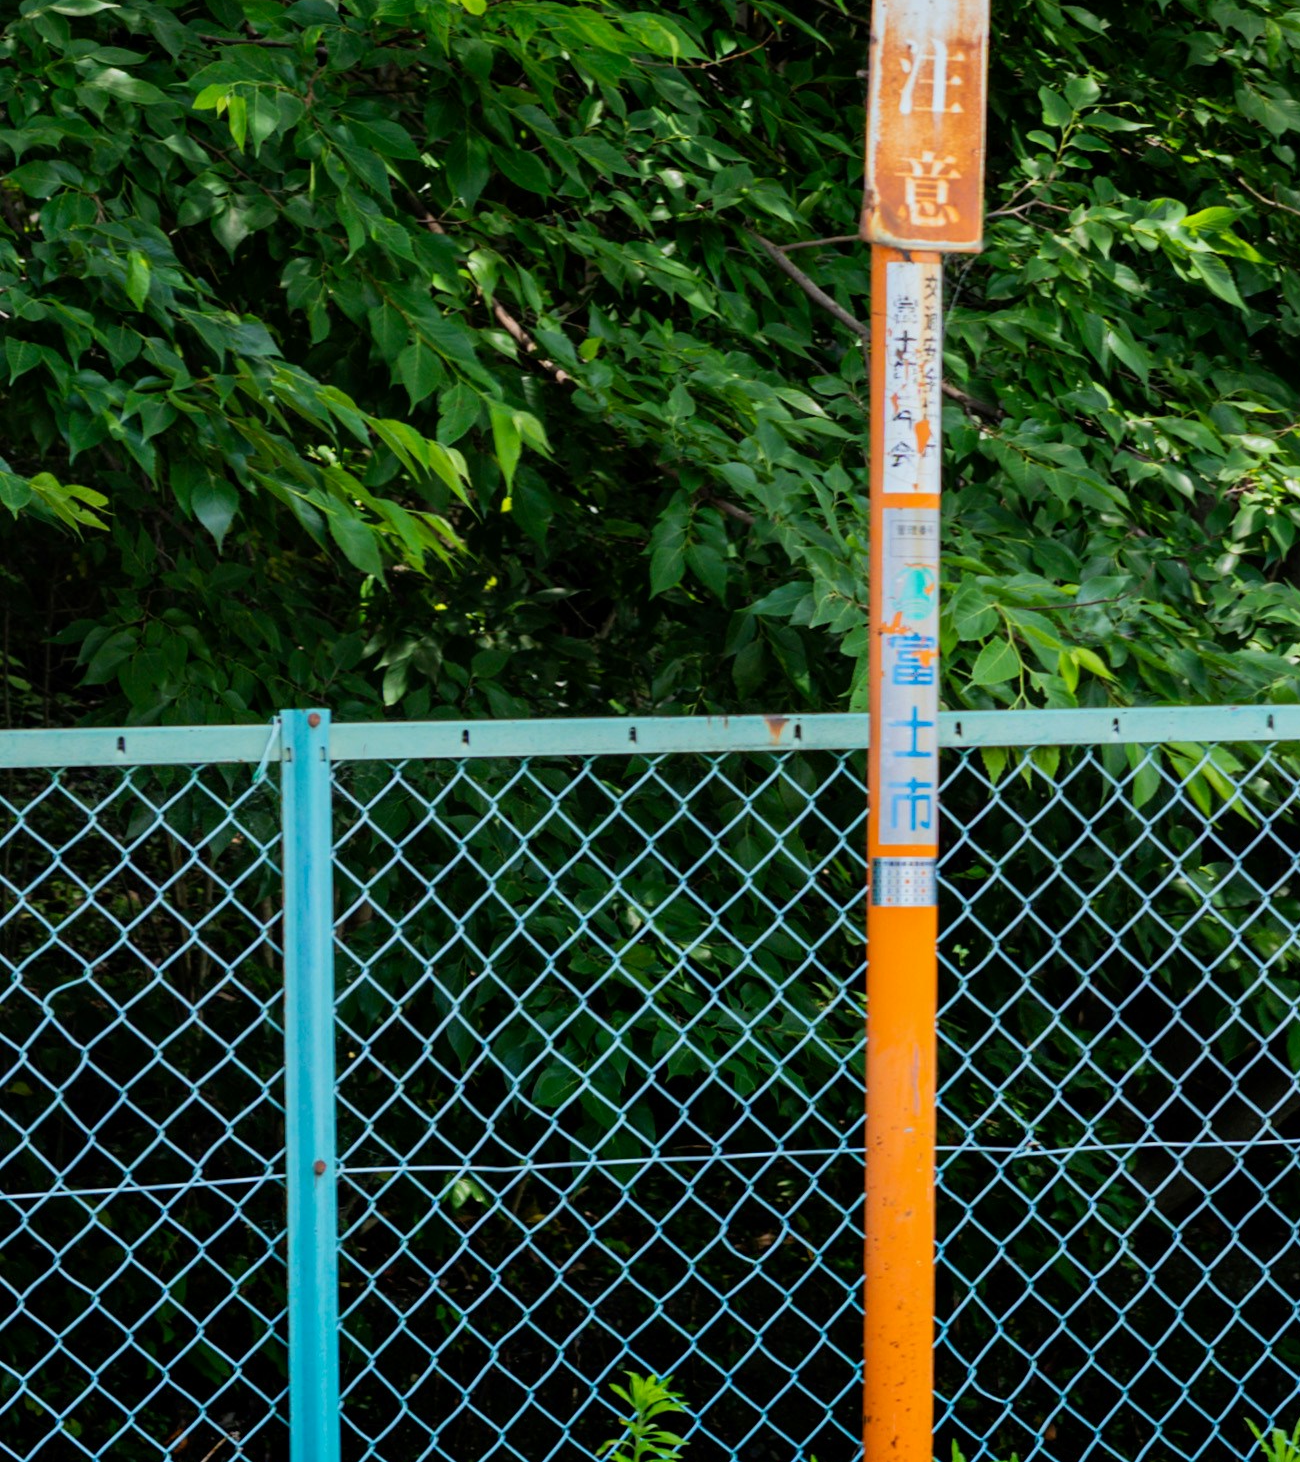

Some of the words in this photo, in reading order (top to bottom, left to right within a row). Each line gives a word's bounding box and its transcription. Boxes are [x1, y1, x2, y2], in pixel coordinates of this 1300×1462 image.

[895, 37, 965, 227] 注意
[887, 632, 936, 831] 富士市
